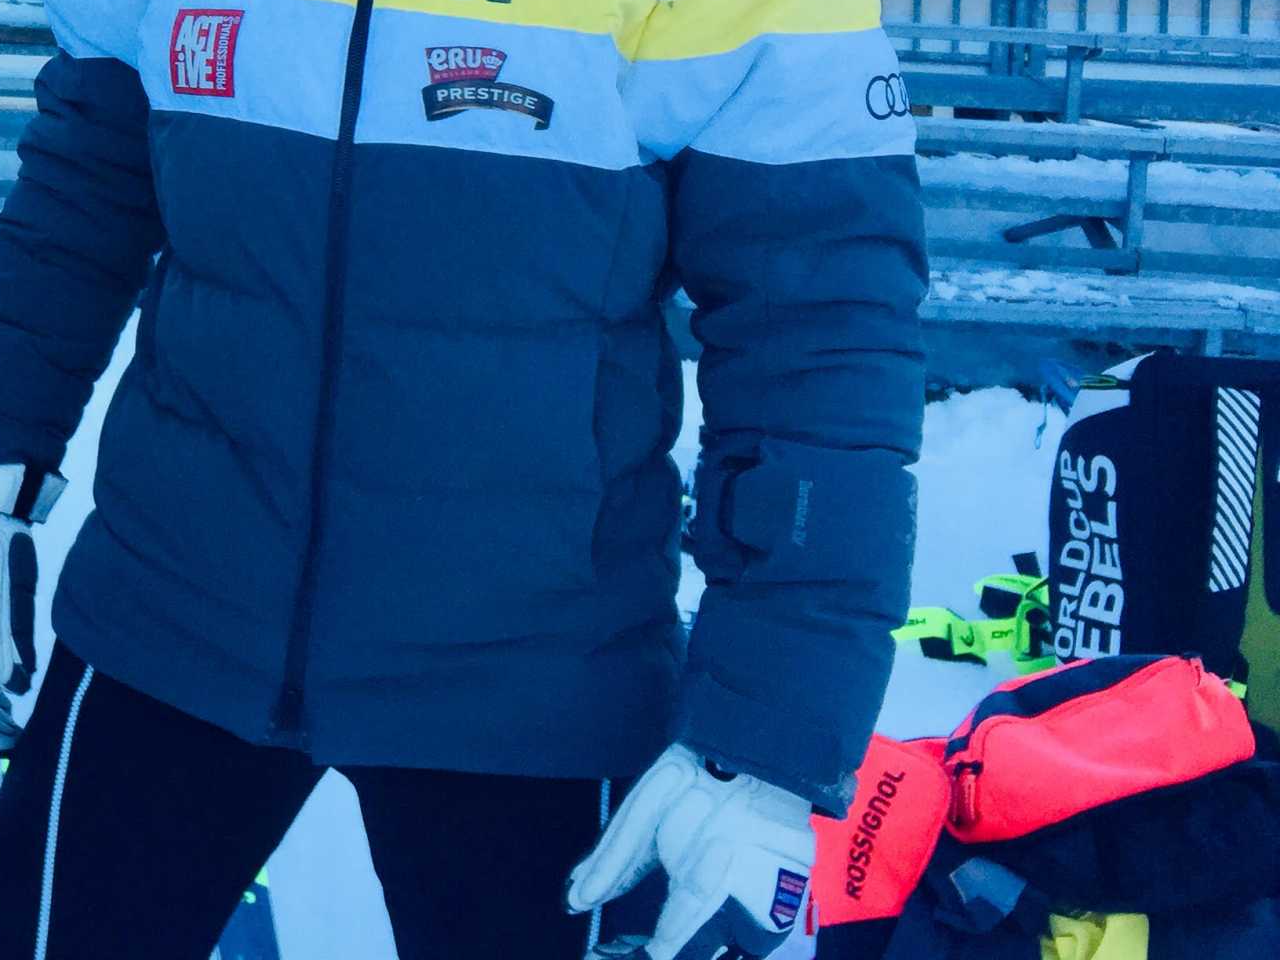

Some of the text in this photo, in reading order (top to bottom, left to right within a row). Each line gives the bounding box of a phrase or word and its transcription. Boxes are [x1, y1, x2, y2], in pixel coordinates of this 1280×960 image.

[436, 87, 539, 110] PRESTIGE
[1054, 448, 1092, 659] ORLDCUP
[1074, 454, 1125, 659] EBELS
[845, 771, 907, 901] ROSSIGNOL
